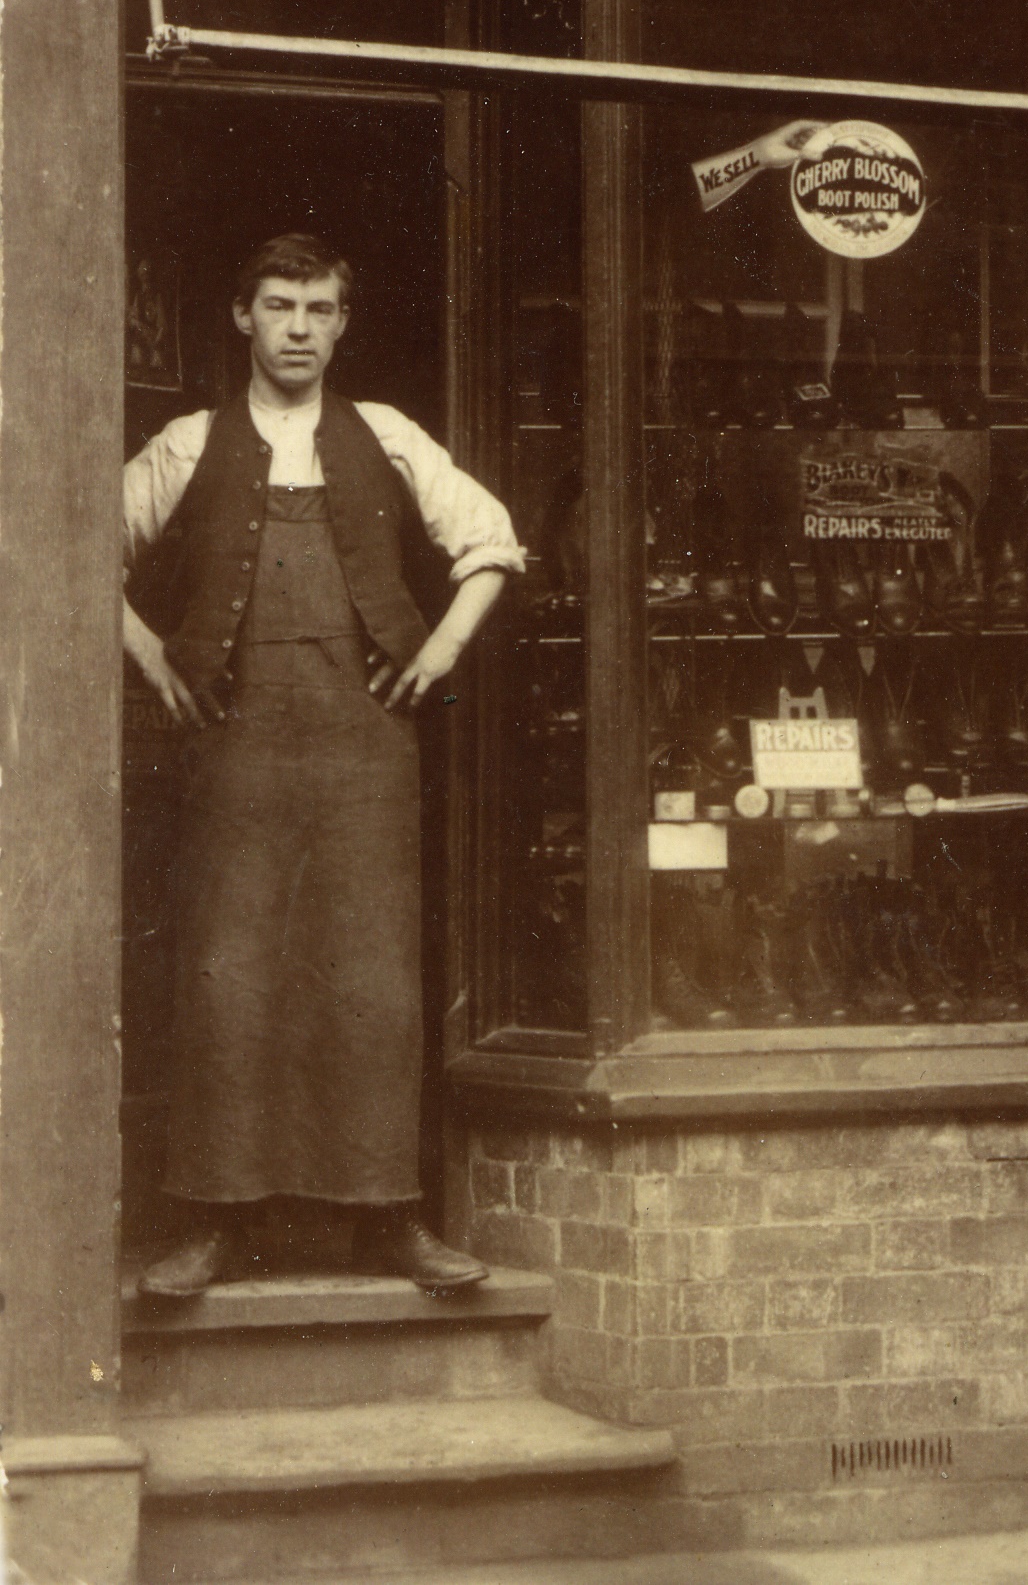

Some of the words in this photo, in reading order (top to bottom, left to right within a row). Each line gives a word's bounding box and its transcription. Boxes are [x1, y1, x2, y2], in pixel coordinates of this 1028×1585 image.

[699, 167, 724, 193] WE
[723, 151, 760, 183] SELL
[797, 158, 851, 196] CHERRY
[854, 158, 920, 206] BLOSSOM
[818, 189, 852, 207] BOOT
[854, 191, 899, 209] POLISH
[804, 514, 882, 539] REPAIRS
[894, 519, 935, 528] NEATLY
[755, 721, 854, 750] REPAIRS
